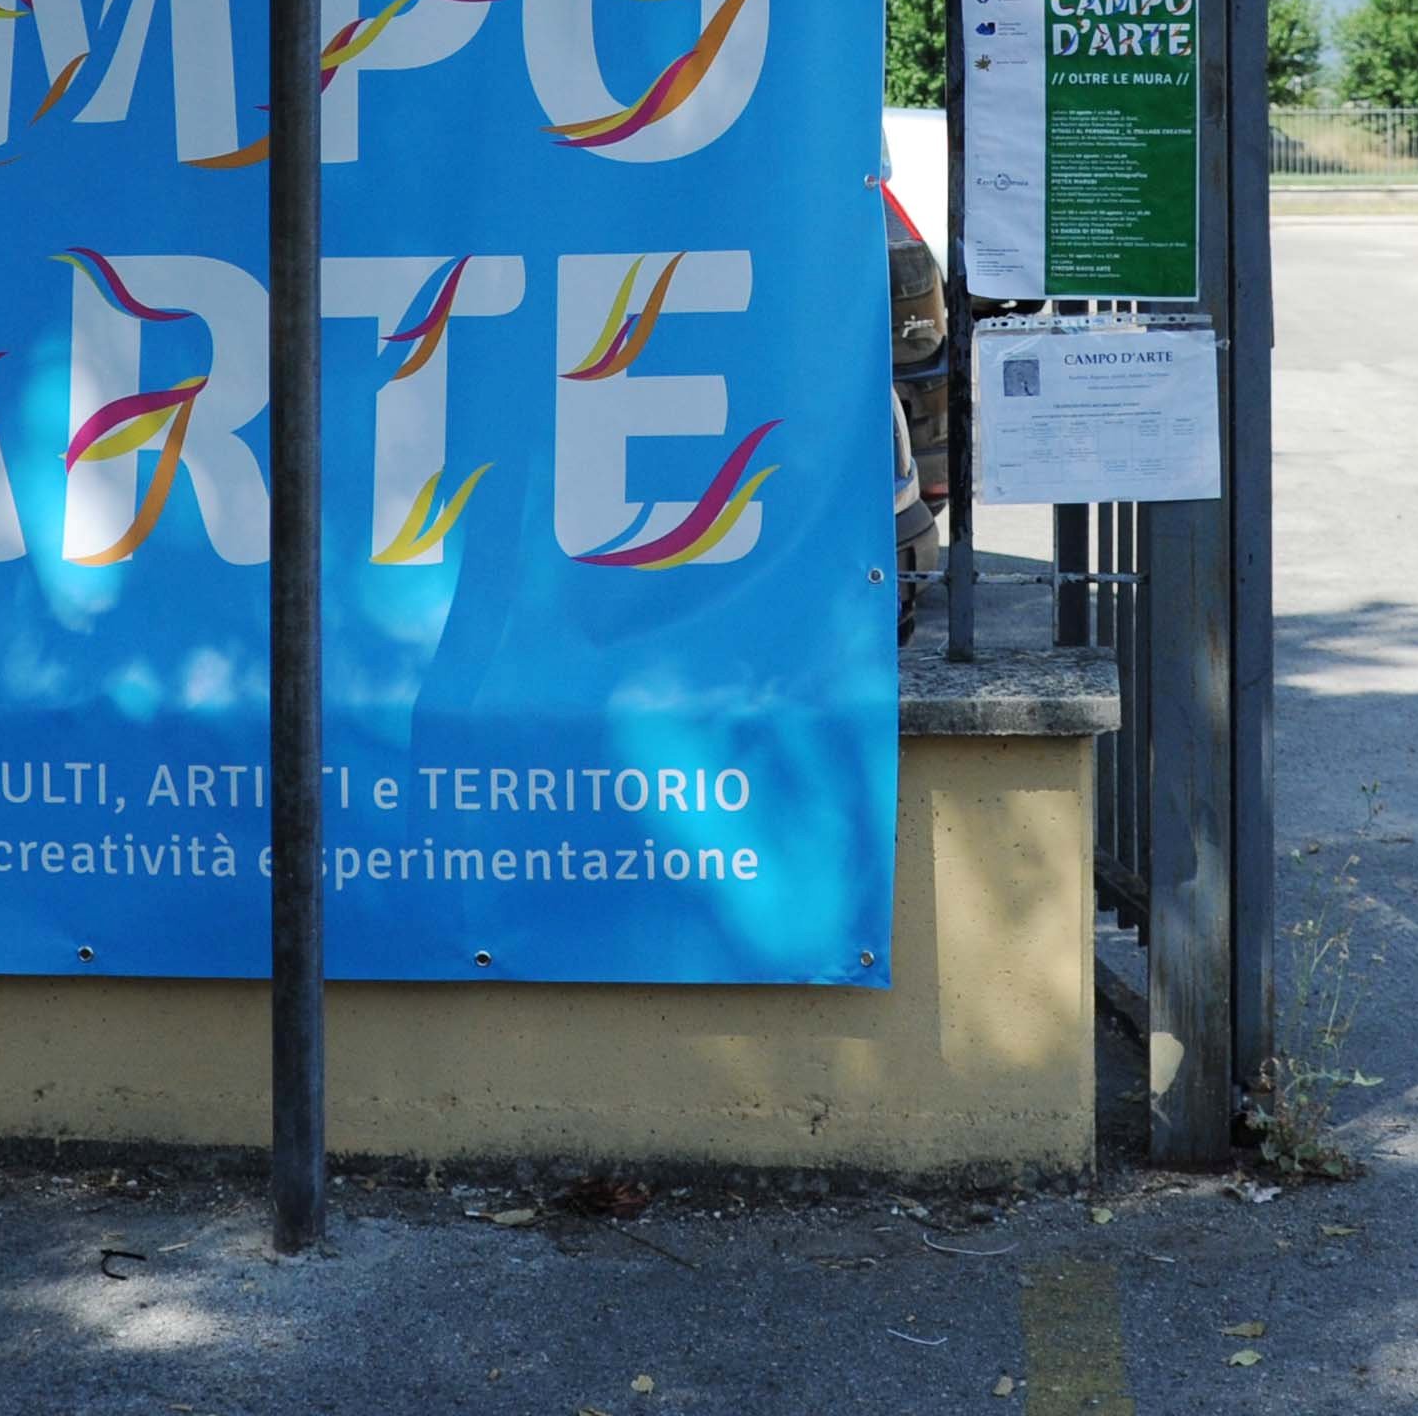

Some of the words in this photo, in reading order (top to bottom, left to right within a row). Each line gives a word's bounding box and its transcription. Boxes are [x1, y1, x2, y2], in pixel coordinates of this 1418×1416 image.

[1068, 74, 1110, 85] OLTRE
[1113, 74, 1129, 85] LE
[1133, 73, 1173, 85] MURA
[1064, 353, 1117, 365] CAMPO
[147, 763, 349, 808] ARTII
[373, 775, 399, 812] e
[419, 768, 752, 812] TERRITORIO
[321, 838, 759, 890] perimentazione
